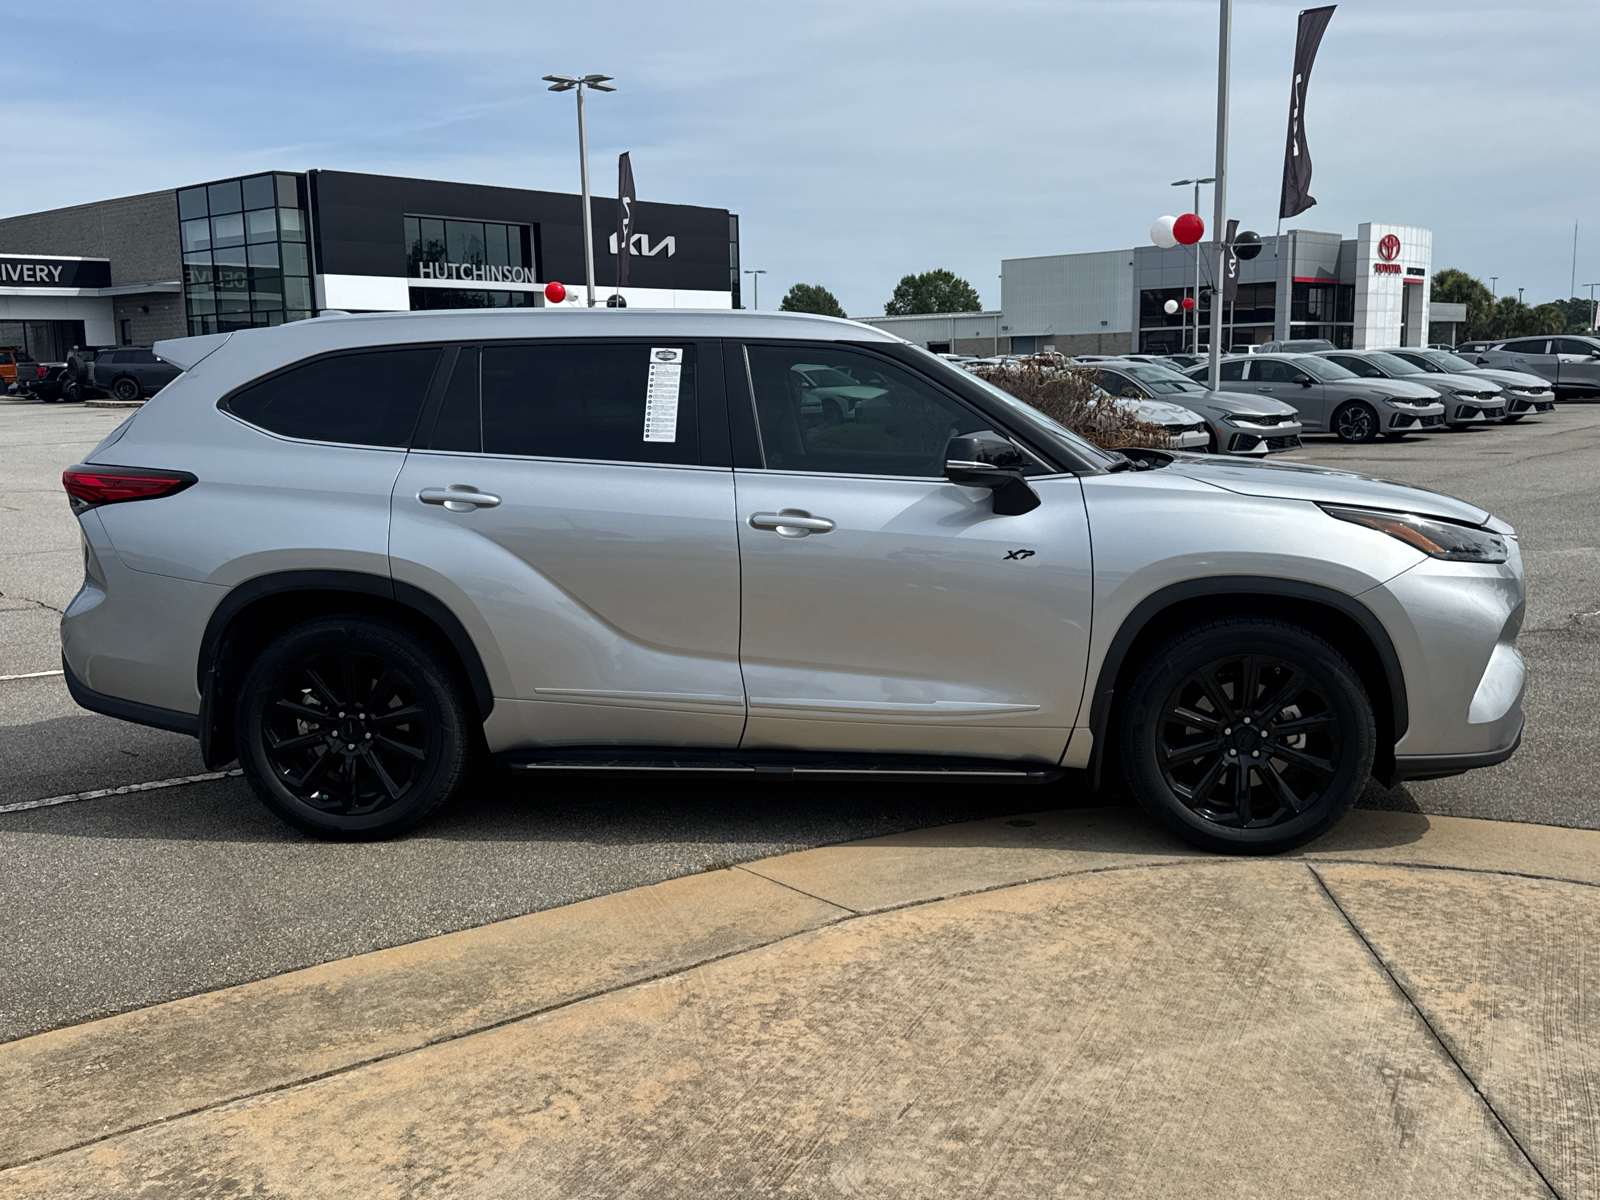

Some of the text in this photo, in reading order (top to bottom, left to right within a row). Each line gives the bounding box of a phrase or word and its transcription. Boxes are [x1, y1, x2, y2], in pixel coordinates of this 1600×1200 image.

[0, 263, 63, 283] IVERY
[419, 261, 536, 284] HUTCHINSON
[1374, 263, 1402, 274] TOYOTA
[1003, 549, 1036, 560] XP
[354, 628, 421, 669] BRIDGESTONE
